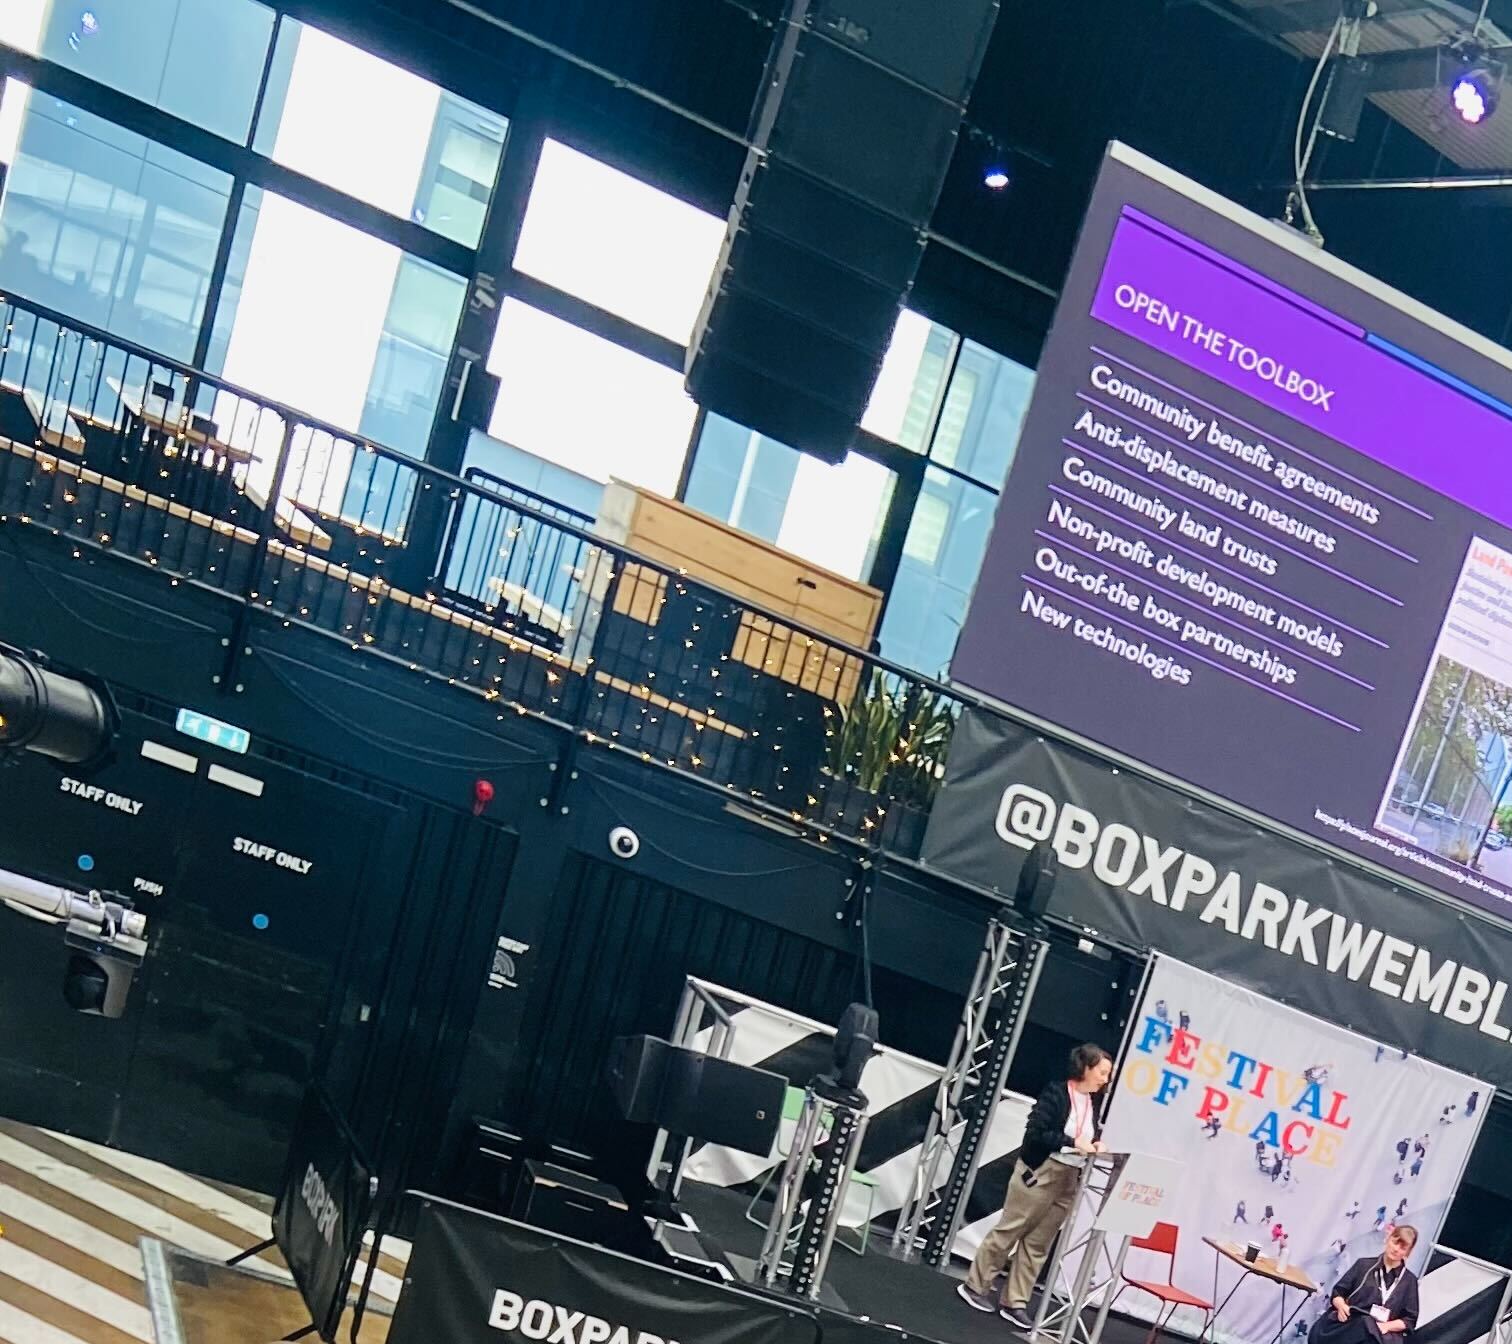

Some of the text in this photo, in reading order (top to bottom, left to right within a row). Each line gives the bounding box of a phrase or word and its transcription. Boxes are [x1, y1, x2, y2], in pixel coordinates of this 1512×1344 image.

[1115, 285, 1335, 411] OPEN THE TOOLBOX
[1073, 411, 1336, 553] Anti-displacement measures
[1090, 365, 1380, 524] Community benefit agreements
[1062, 457, 1278, 575] Community land trusts
[1020, 589, 1192, 685] New technologies
[1034, 547, 1296, 684] Out-of-the box partnerships
[1047, 500, 1343, 657] Non-profit development models
[60, 777, 143, 815] STAFF ONLY
[233, 836, 312, 874] STAFF ONLY
[1124, 1059, 1343, 1168] OF PLACE
[1136, 1016, 1351, 1130] FESTIVAL
